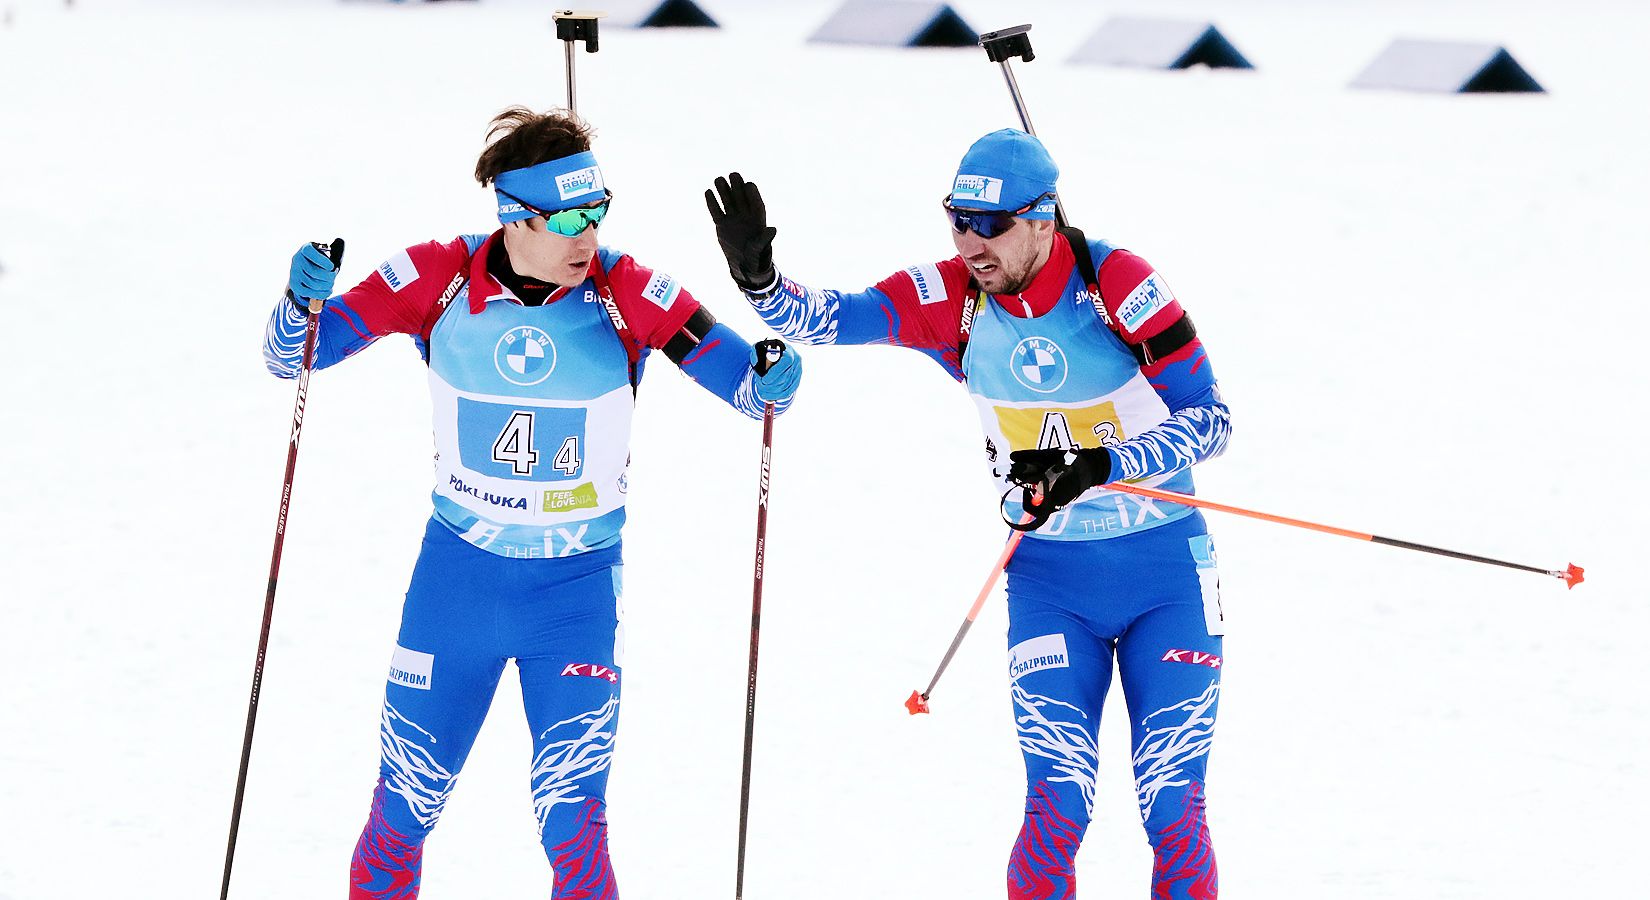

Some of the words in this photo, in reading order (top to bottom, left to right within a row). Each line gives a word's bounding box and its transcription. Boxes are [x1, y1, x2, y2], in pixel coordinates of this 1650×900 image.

[437, 272, 464, 308] SWIX
[602, 285, 628, 330] SWIX
[960, 296, 975, 334] SWIX
[1090, 290, 1113, 325] SWIX
[1123, 295, 1149, 321] RBU
[504, 329, 549, 346] BMW
[1018, 339, 1057, 356] BMW
[290, 364, 310, 450] SWIX
[492, 411, 538, 475] 4
[1093, 422, 1121, 446] 3
[553, 437, 580, 475] 4
[759, 443, 771, 511] SWIX
[450, 474, 527, 510] POKLJUKA
[553, 490, 574, 500] FEEL
[1080, 516, 1118, 534] THE
[503, 545, 540, 558] THE
[1018, 654, 1065, 673] GAZPROM
[1162, 649, 1220, 668] KV+
[561, 663, 617, 682] KV+
